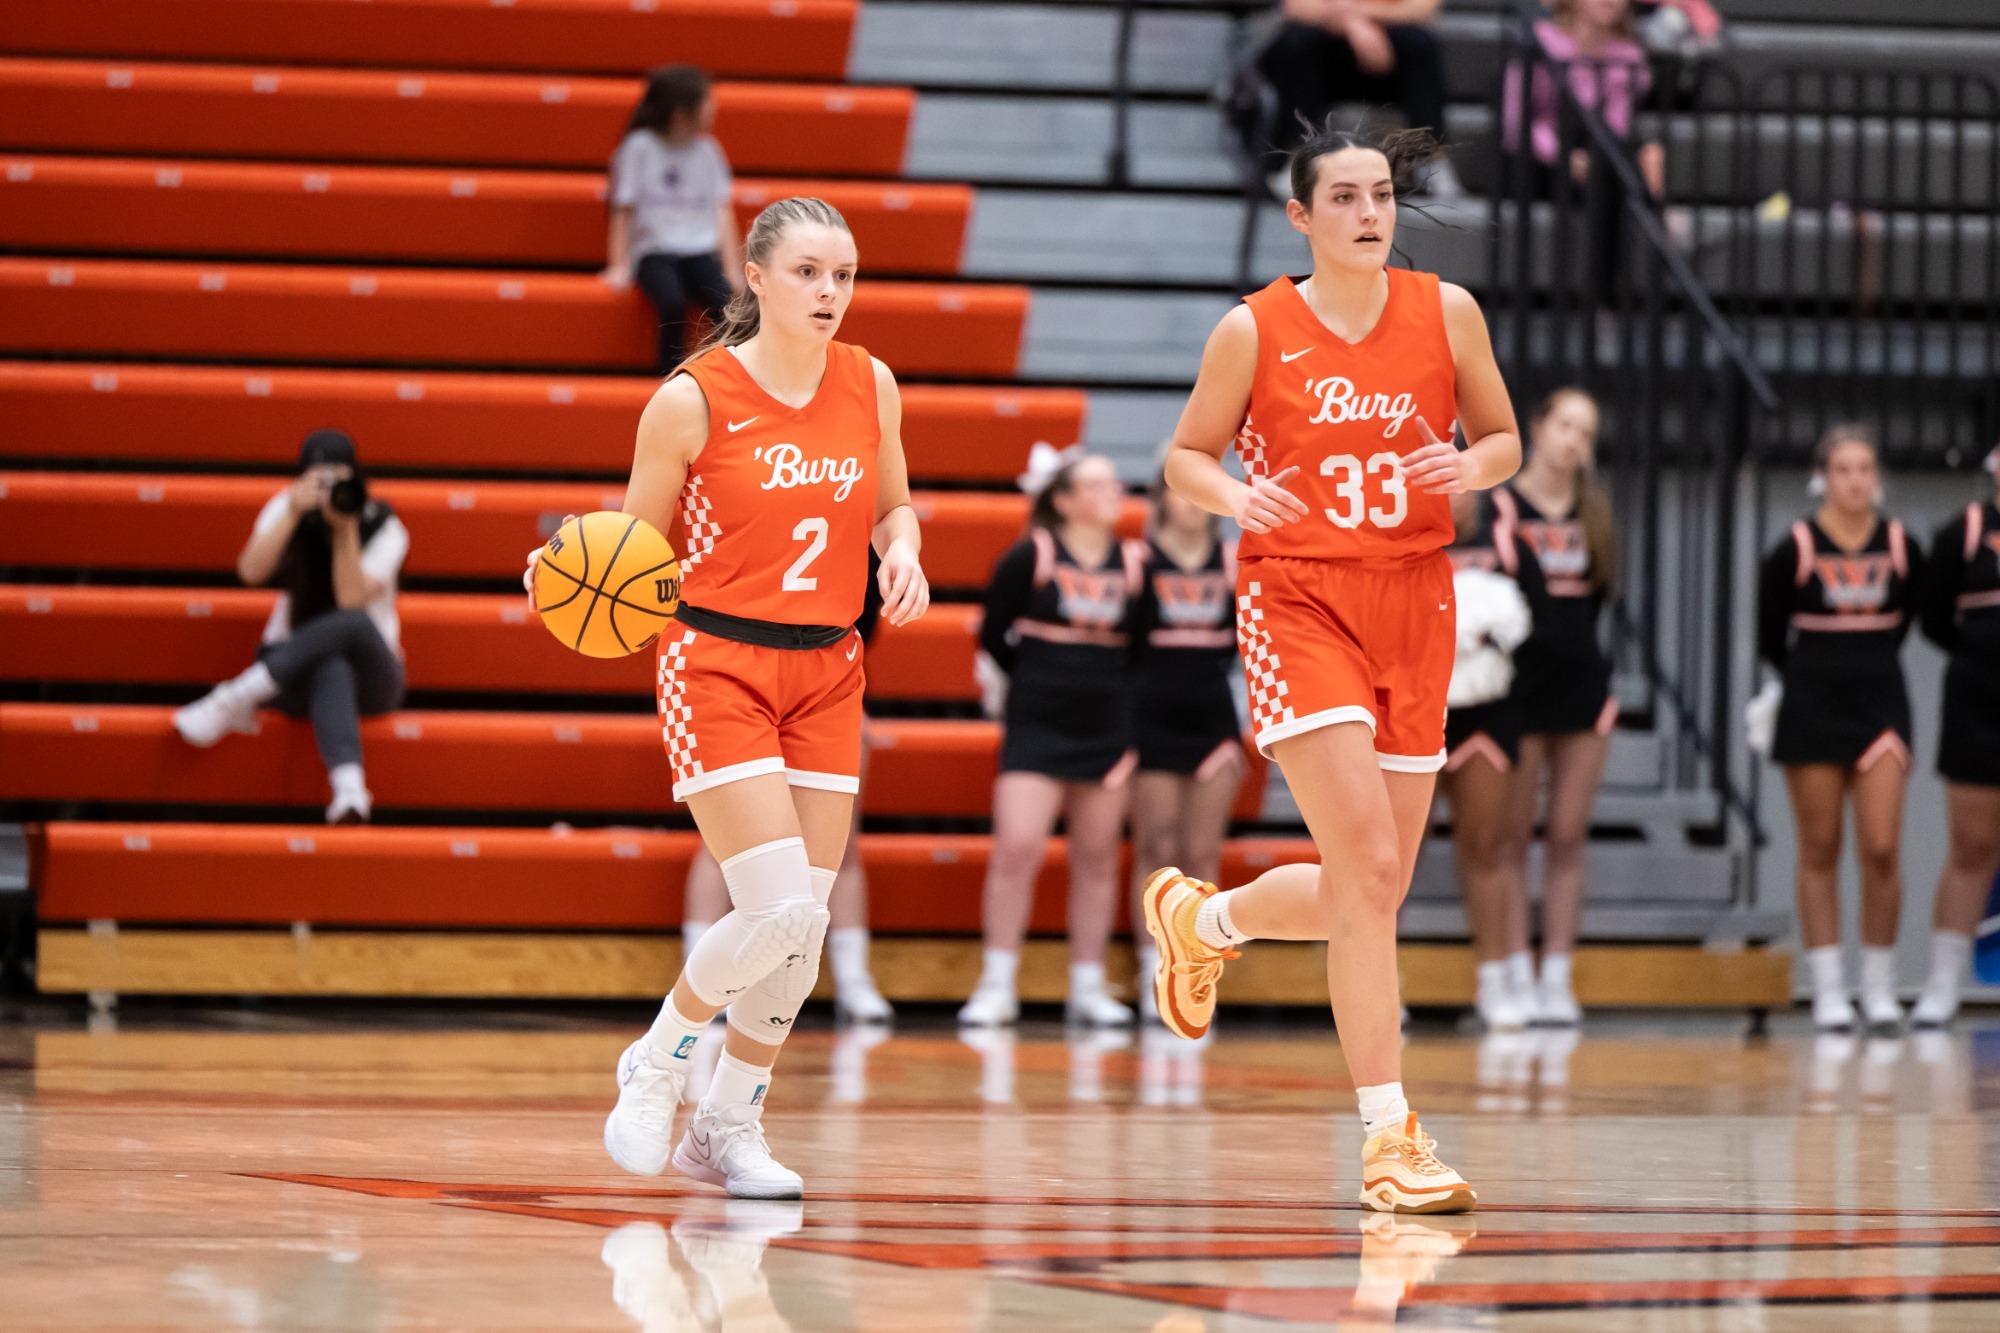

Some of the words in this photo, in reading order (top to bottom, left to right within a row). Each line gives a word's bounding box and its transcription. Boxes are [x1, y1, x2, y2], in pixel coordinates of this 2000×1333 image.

[1304, 376, 1416, 439] 'Burg
[753, 443, 864, 503] 'Burg
[1319, 451, 1408, 530] 33
[782, 516, 829, 592] 2
